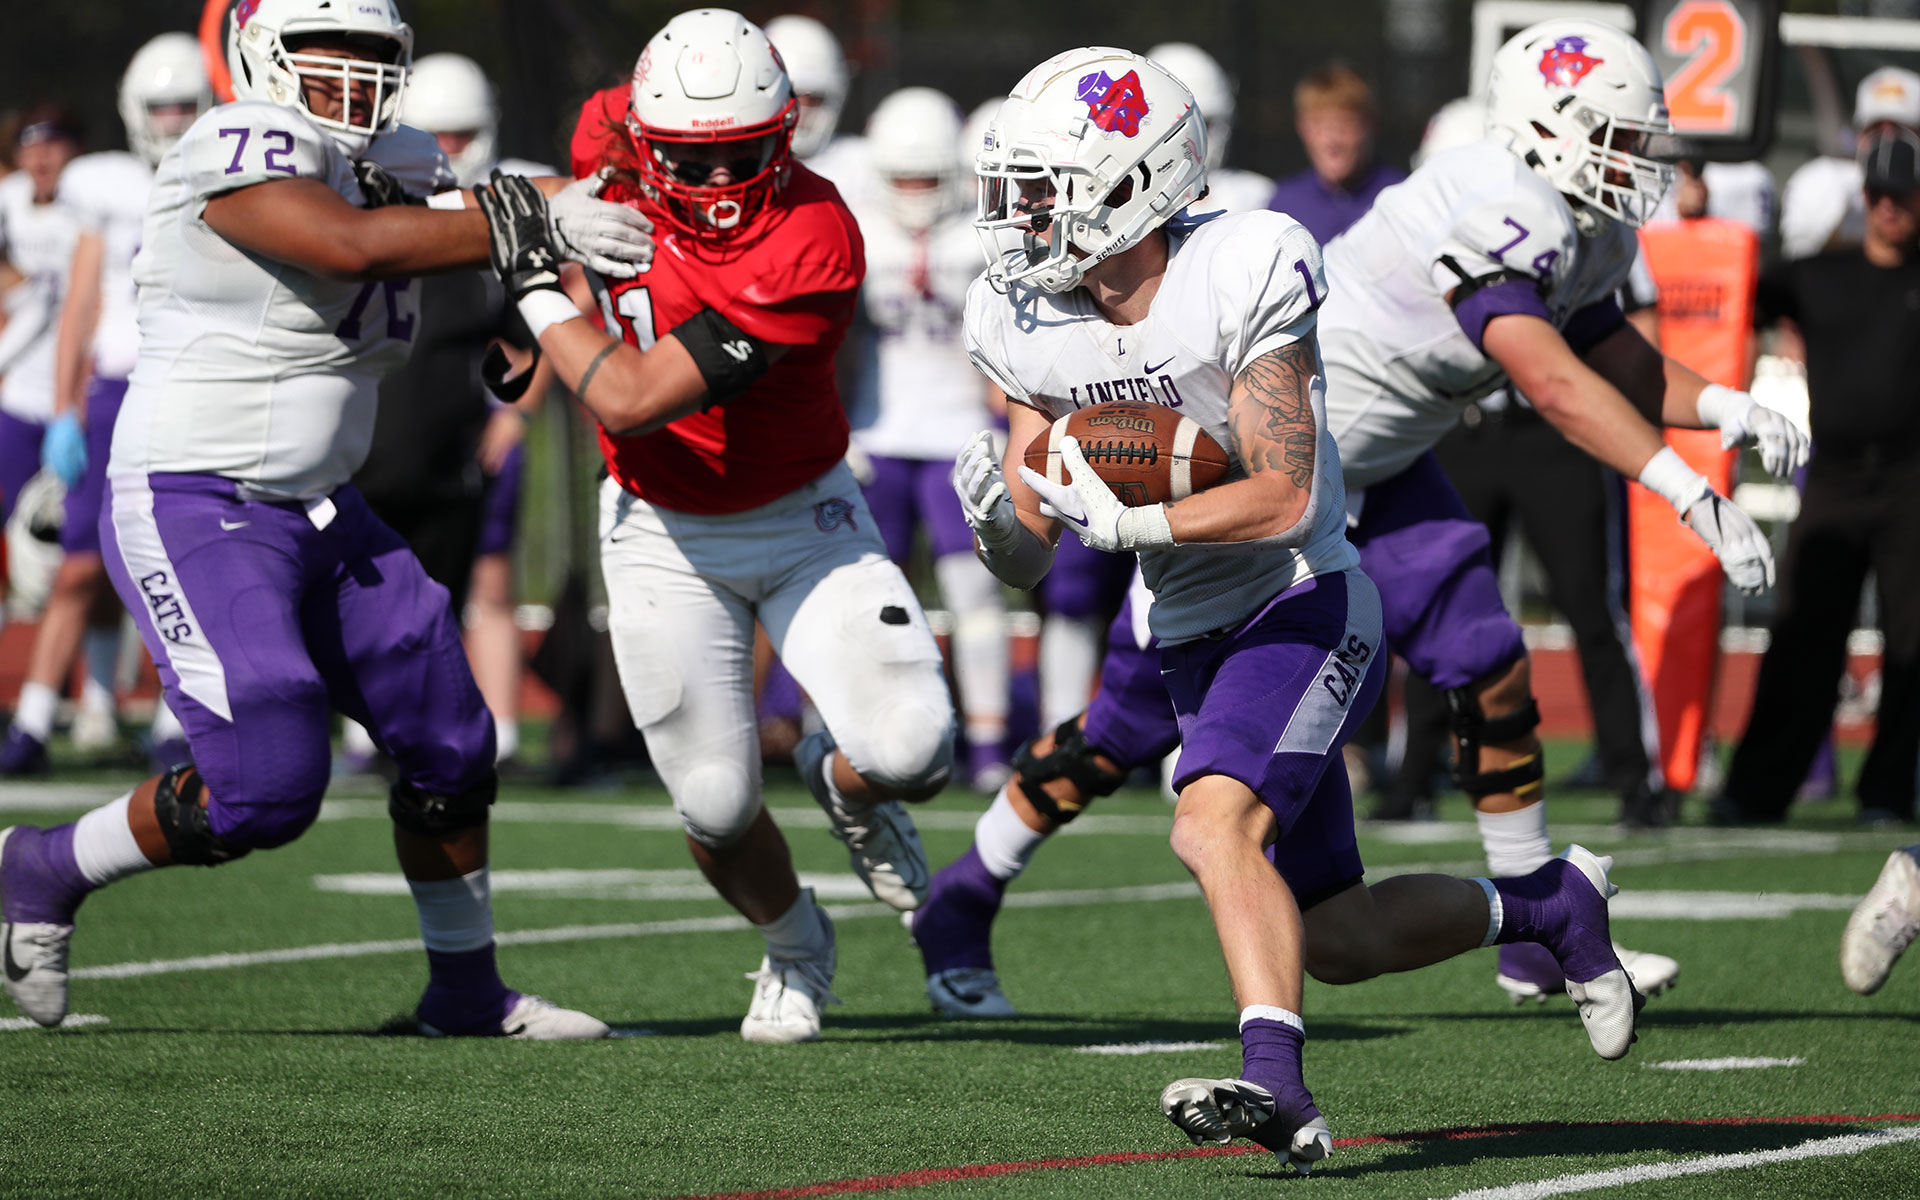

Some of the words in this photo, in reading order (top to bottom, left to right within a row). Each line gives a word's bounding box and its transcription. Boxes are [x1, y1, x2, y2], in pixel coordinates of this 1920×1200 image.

[1663, 0, 1745, 132] 2
[691, 117, 734, 128] Riddell
[218, 127, 297, 175] 72
[1095, 234, 1127, 262] schutt
[1488, 216, 1559, 279] 74
[1293, 258, 1320, 315] 1
[1117, 338, 1126, 356] L
[1086, 416, 1155, 434] Wilson
[141, 571, 192, 643] CATS
[1323, 634, 1370, 707] CATS
